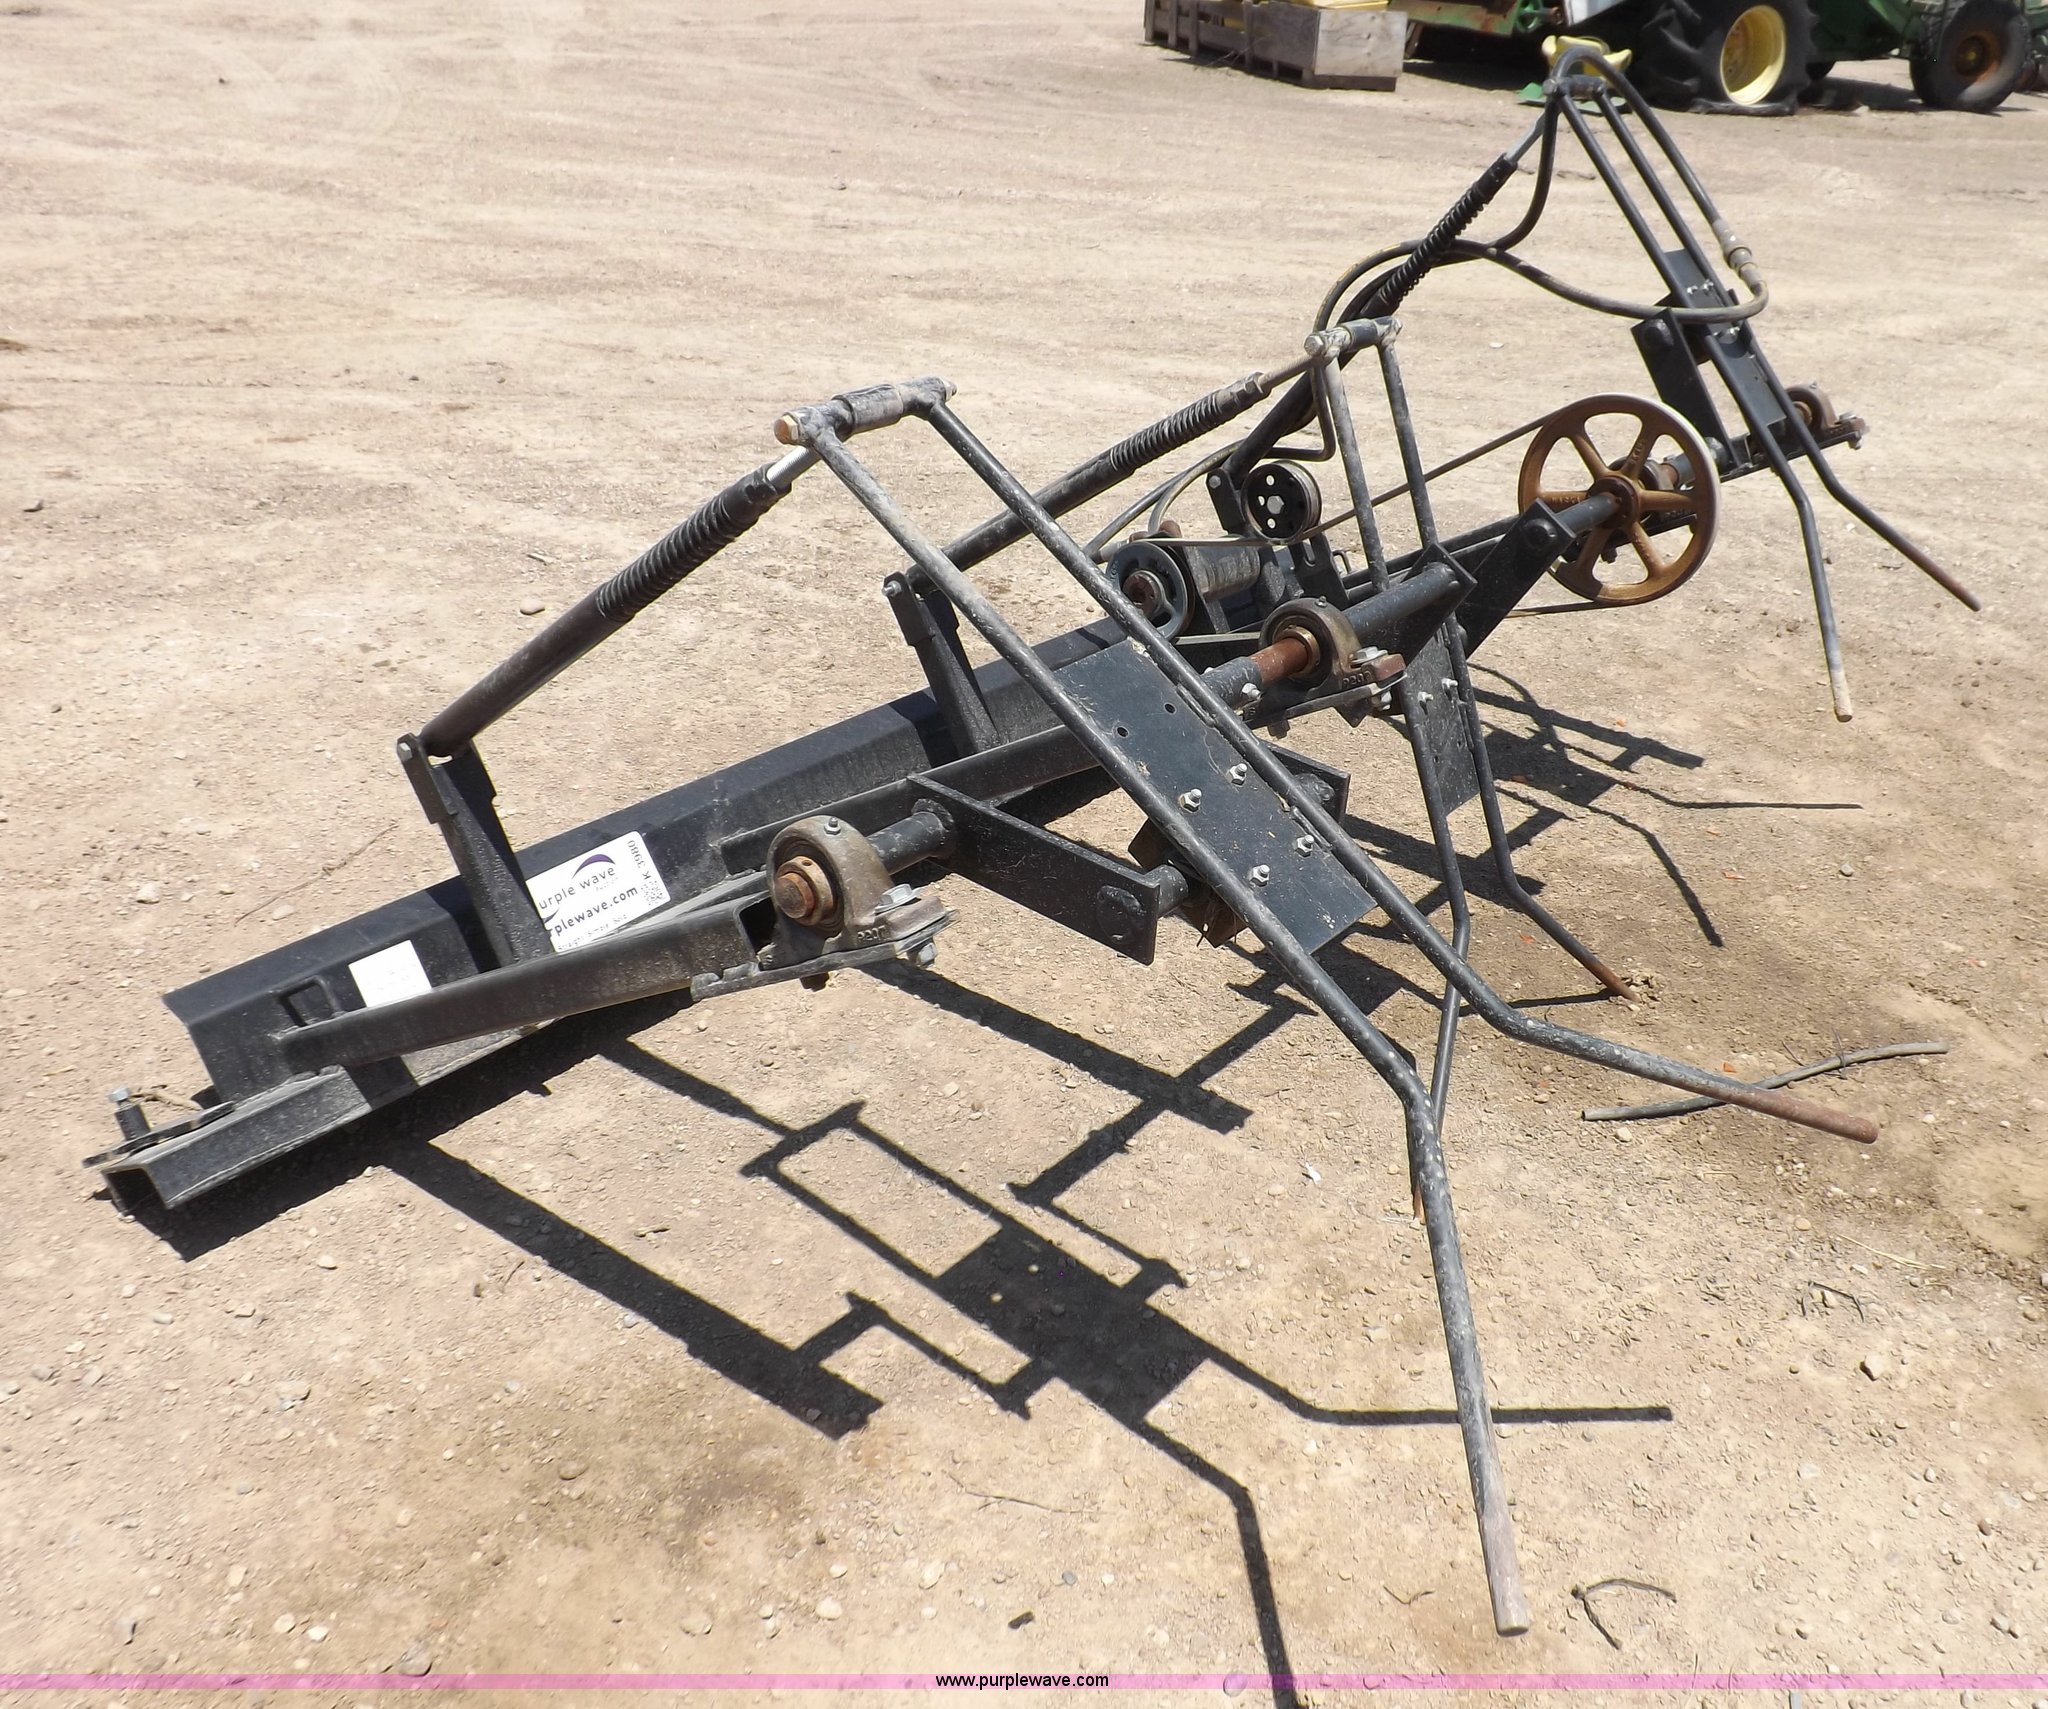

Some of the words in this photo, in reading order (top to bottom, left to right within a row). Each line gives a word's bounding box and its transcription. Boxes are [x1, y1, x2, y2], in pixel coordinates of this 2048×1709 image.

[538, 886, 576, 910] urple
[579, 867, 616, 889] wave
[547, 887, 638, 937] rplewave.com
